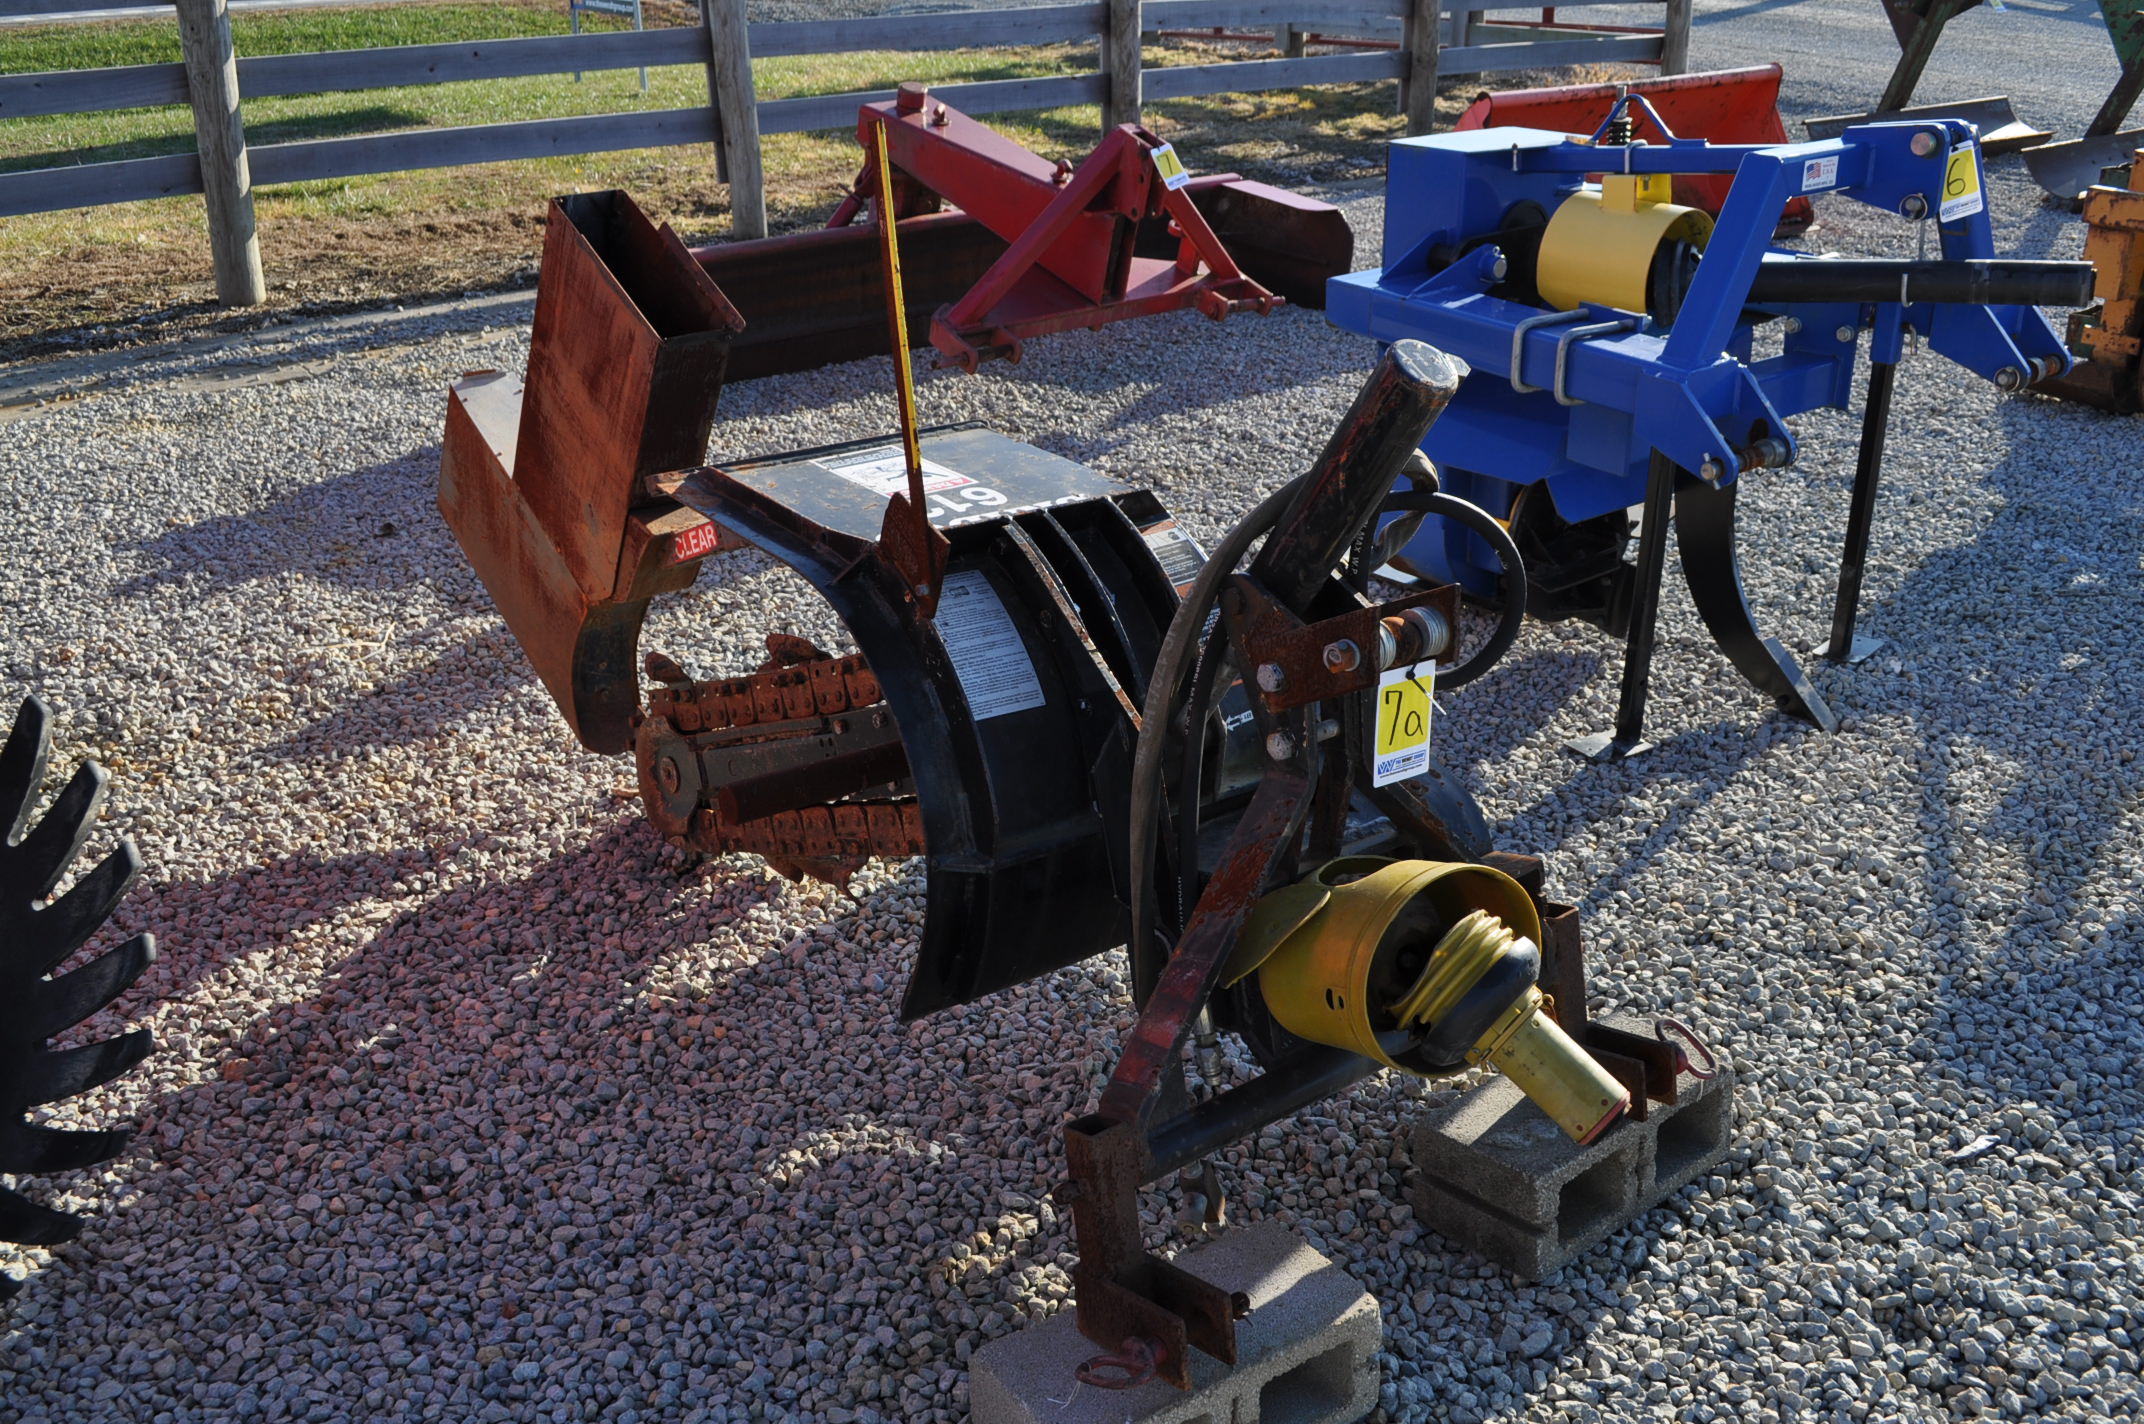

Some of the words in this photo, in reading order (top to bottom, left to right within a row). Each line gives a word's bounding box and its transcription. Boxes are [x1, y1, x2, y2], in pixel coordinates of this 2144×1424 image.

[1946, 157, 1967, 197] 6
[674, 524, 717, 560] CLEAR
[1385, 689, 1425, 746] 7a
